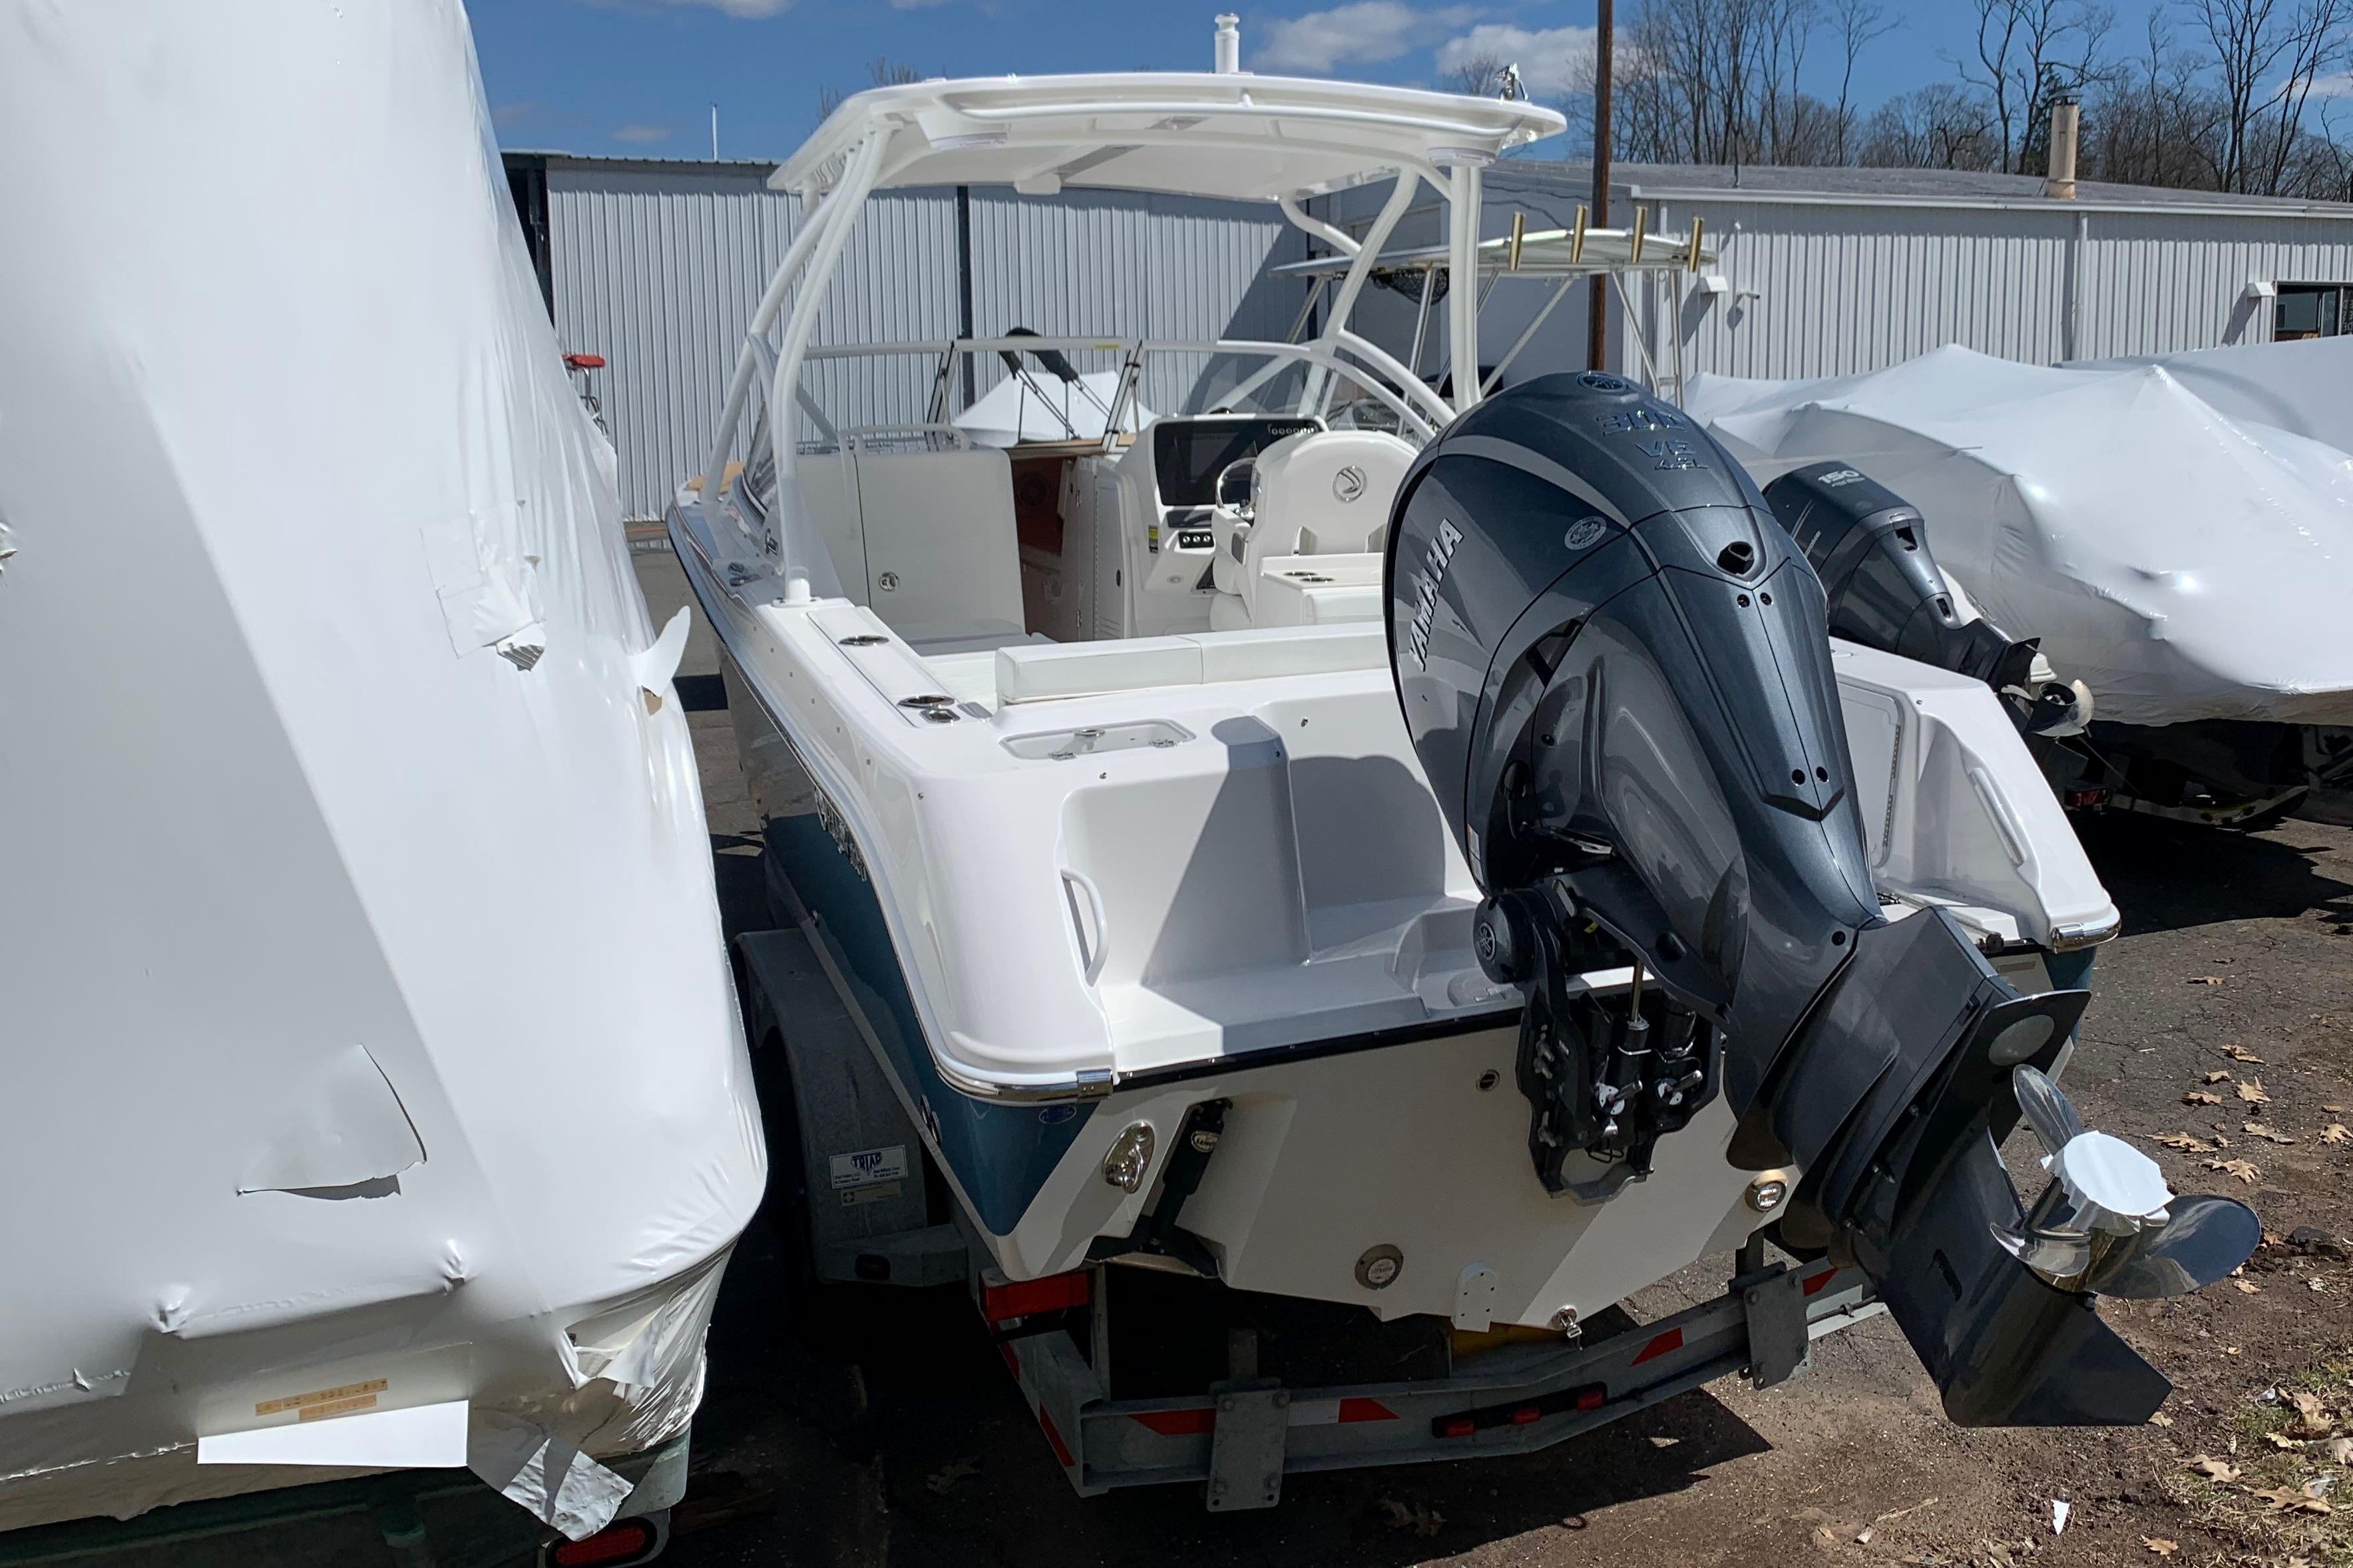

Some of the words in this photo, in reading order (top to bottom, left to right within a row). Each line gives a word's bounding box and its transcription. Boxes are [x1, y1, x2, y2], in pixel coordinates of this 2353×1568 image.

[1596, 410, 1688, 437] 300
[1634, 439, 1697, 459] V6
[1817, 469, 1860, 485] 150
[1408, 517, 1465, 672] YAMAHA
[851, 1151, 883, 1173] TRIAD
